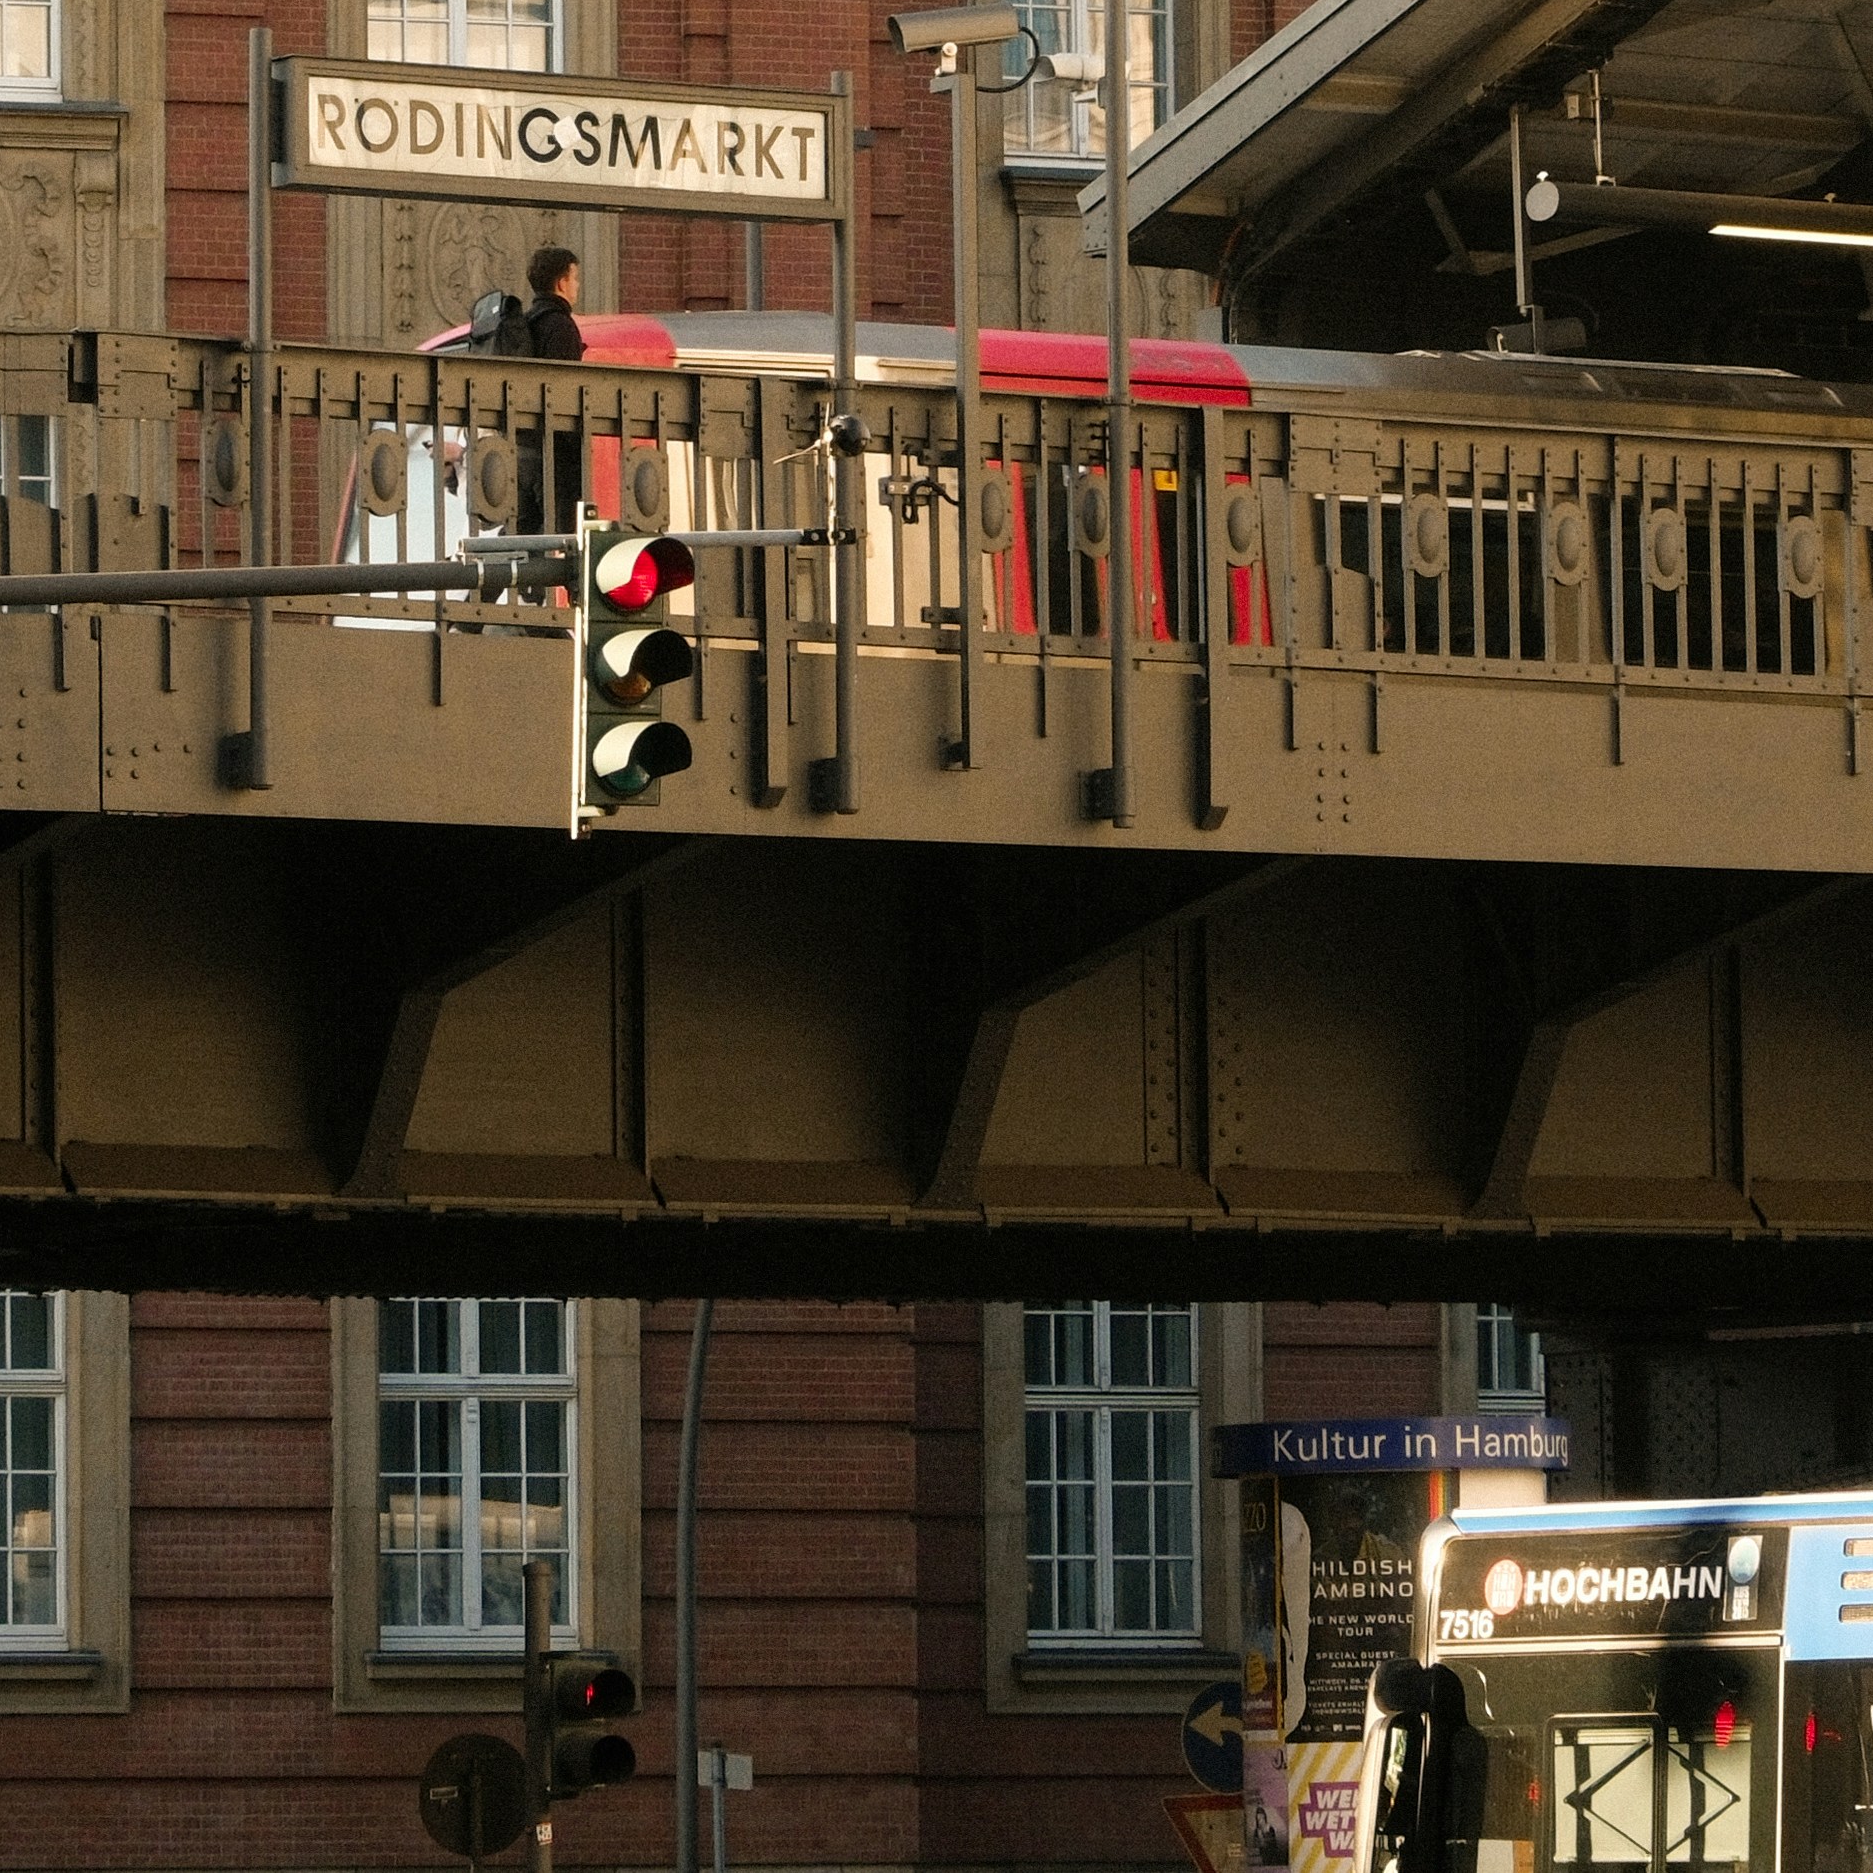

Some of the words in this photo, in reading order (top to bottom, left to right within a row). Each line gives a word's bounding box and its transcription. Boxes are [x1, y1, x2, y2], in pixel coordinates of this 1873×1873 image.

[316, 93, 816, 182] RÖDINGSMARKT
[1273, 1428, 1387, 1462] Kultur
[1404, 1425, 1437, 1458] in
[1455, 1424, 1569, 1466] Hamburg
[1312, 1559, 1413, 1576] HILDISH
[1313, 1581, 1414, 1599] AMBINO
[1524, 1564, 1723, 1605] HOCHBAHN
[1328, 1614, 1359, 1625] NEW
[1364, 1613, 1414, 1624] WORLD
[1440, 1609, 1494, 1639] 7516
[1337, 1627, 1374, 1637] TOUR
[1315, 1651, 1357, 1661] SPECIAL
[1360, 1650, 1395, 1659] GUEST
[1305, 1809, 1357, 1830] WET
